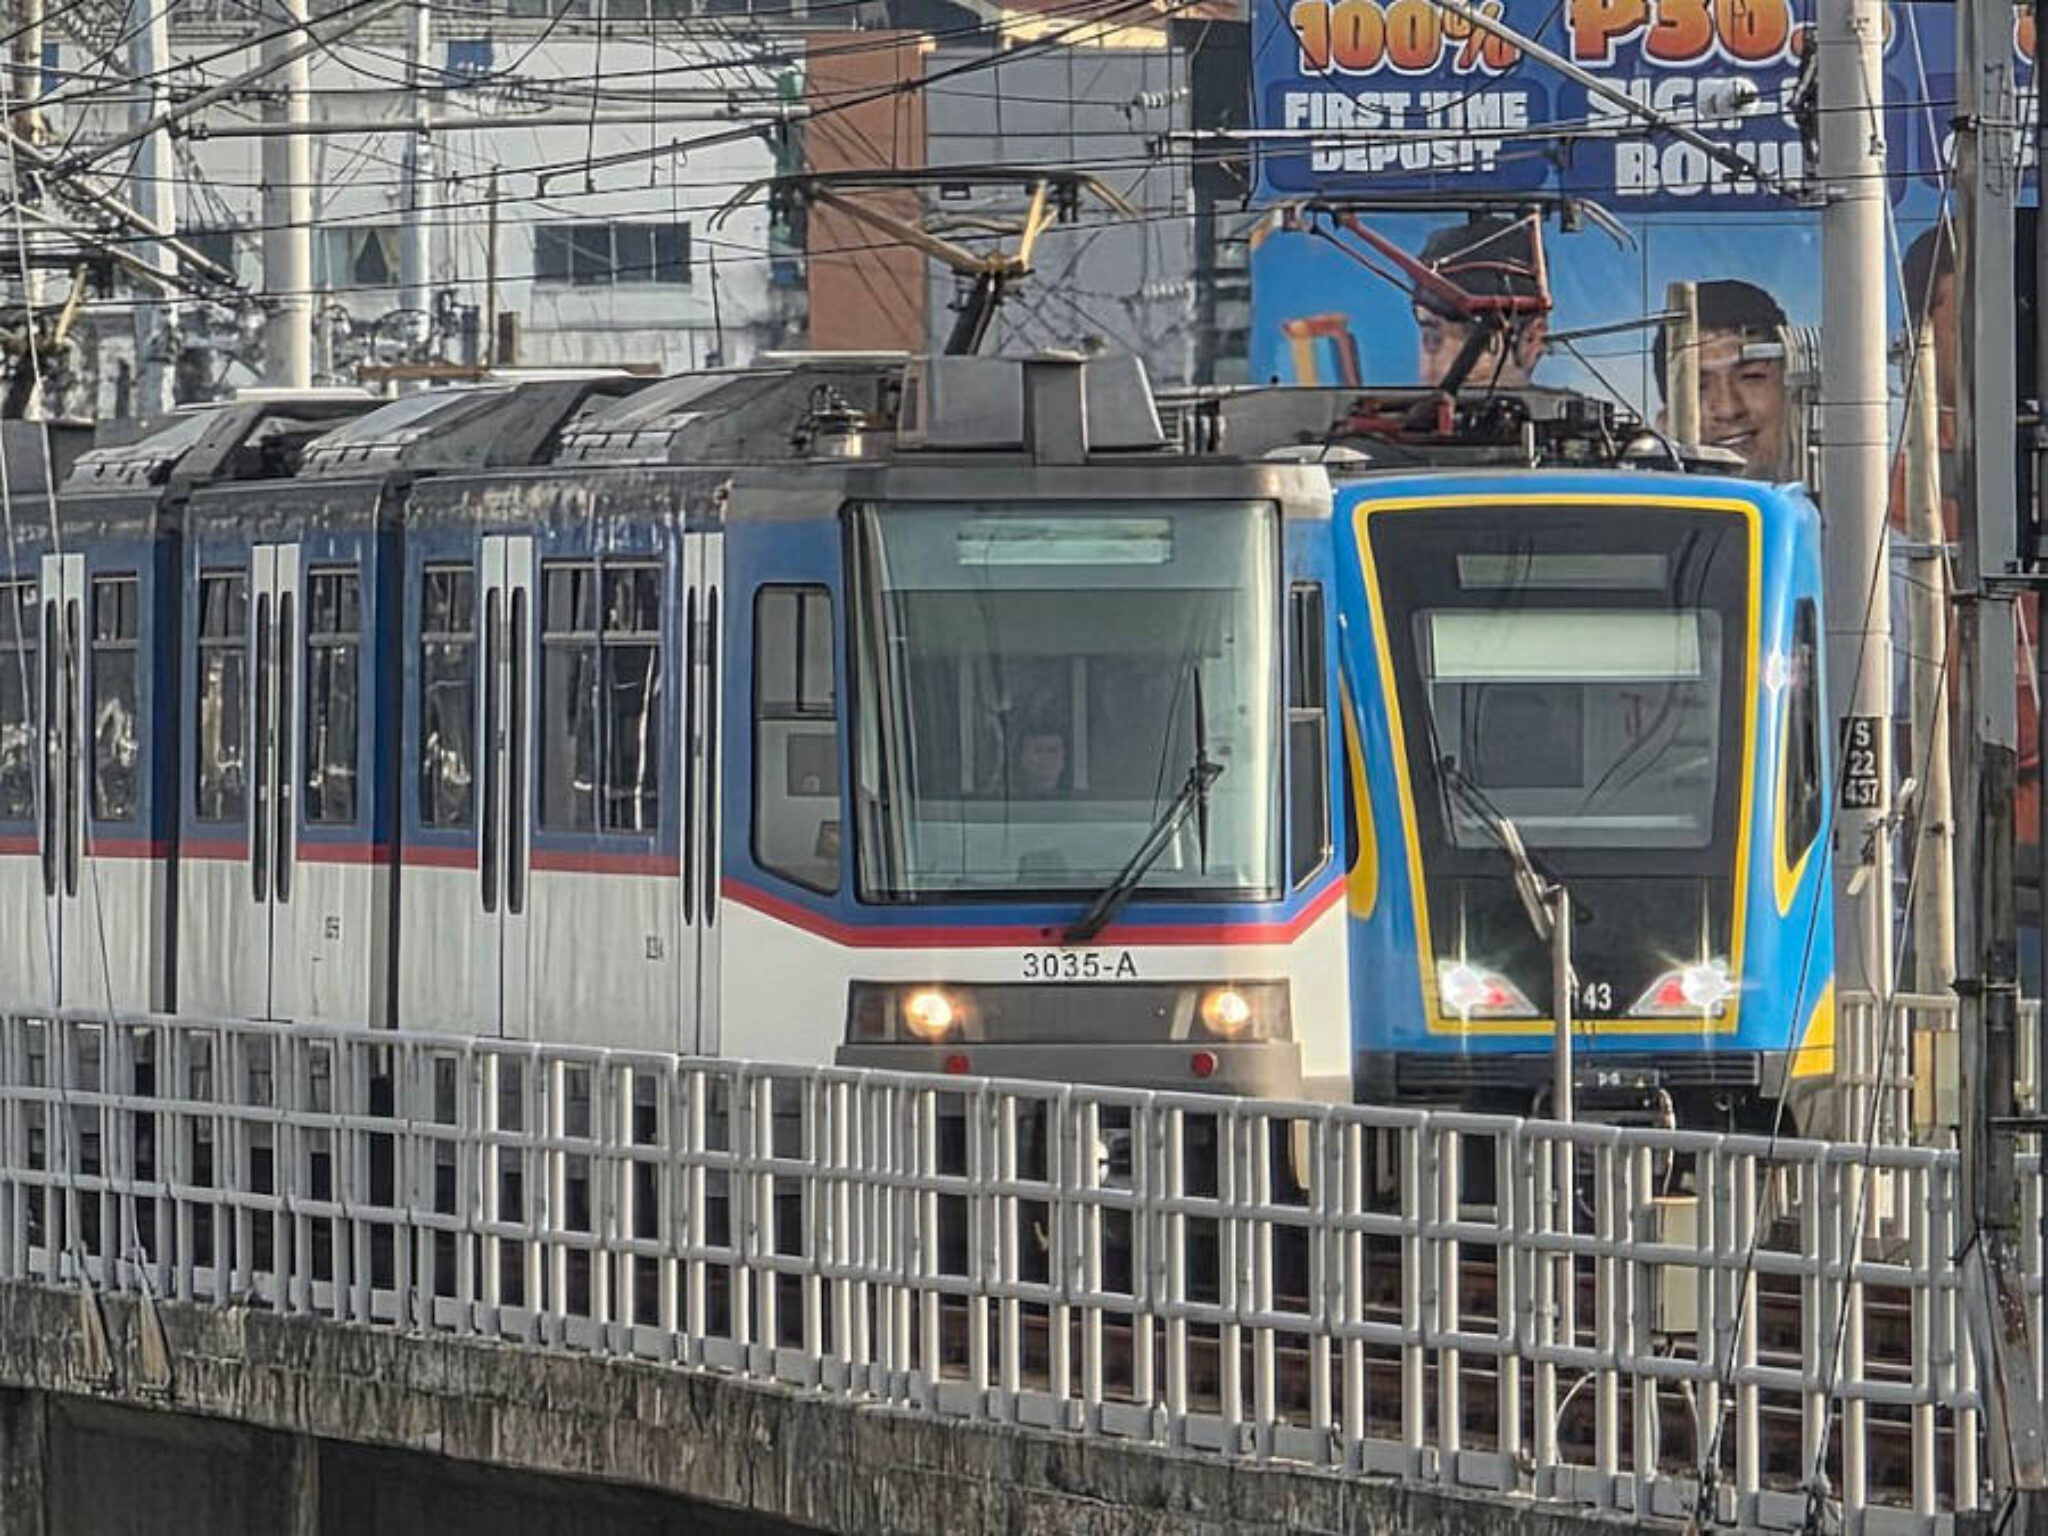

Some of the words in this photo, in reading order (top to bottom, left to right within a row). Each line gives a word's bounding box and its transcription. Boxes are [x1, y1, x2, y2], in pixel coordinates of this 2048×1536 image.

[1292, 0, 1521, 75] 100%
[1285, 92, 1411, 128] FIRST
[1420, 92, 1528, 128] TIME
[1310, 138, 1502, 171] DEPOSIT
[1856, 721, 1870, 747] S
[1850, 750, 1875, 776] 22
[1023, 951, 1138, 978] 3035-A
